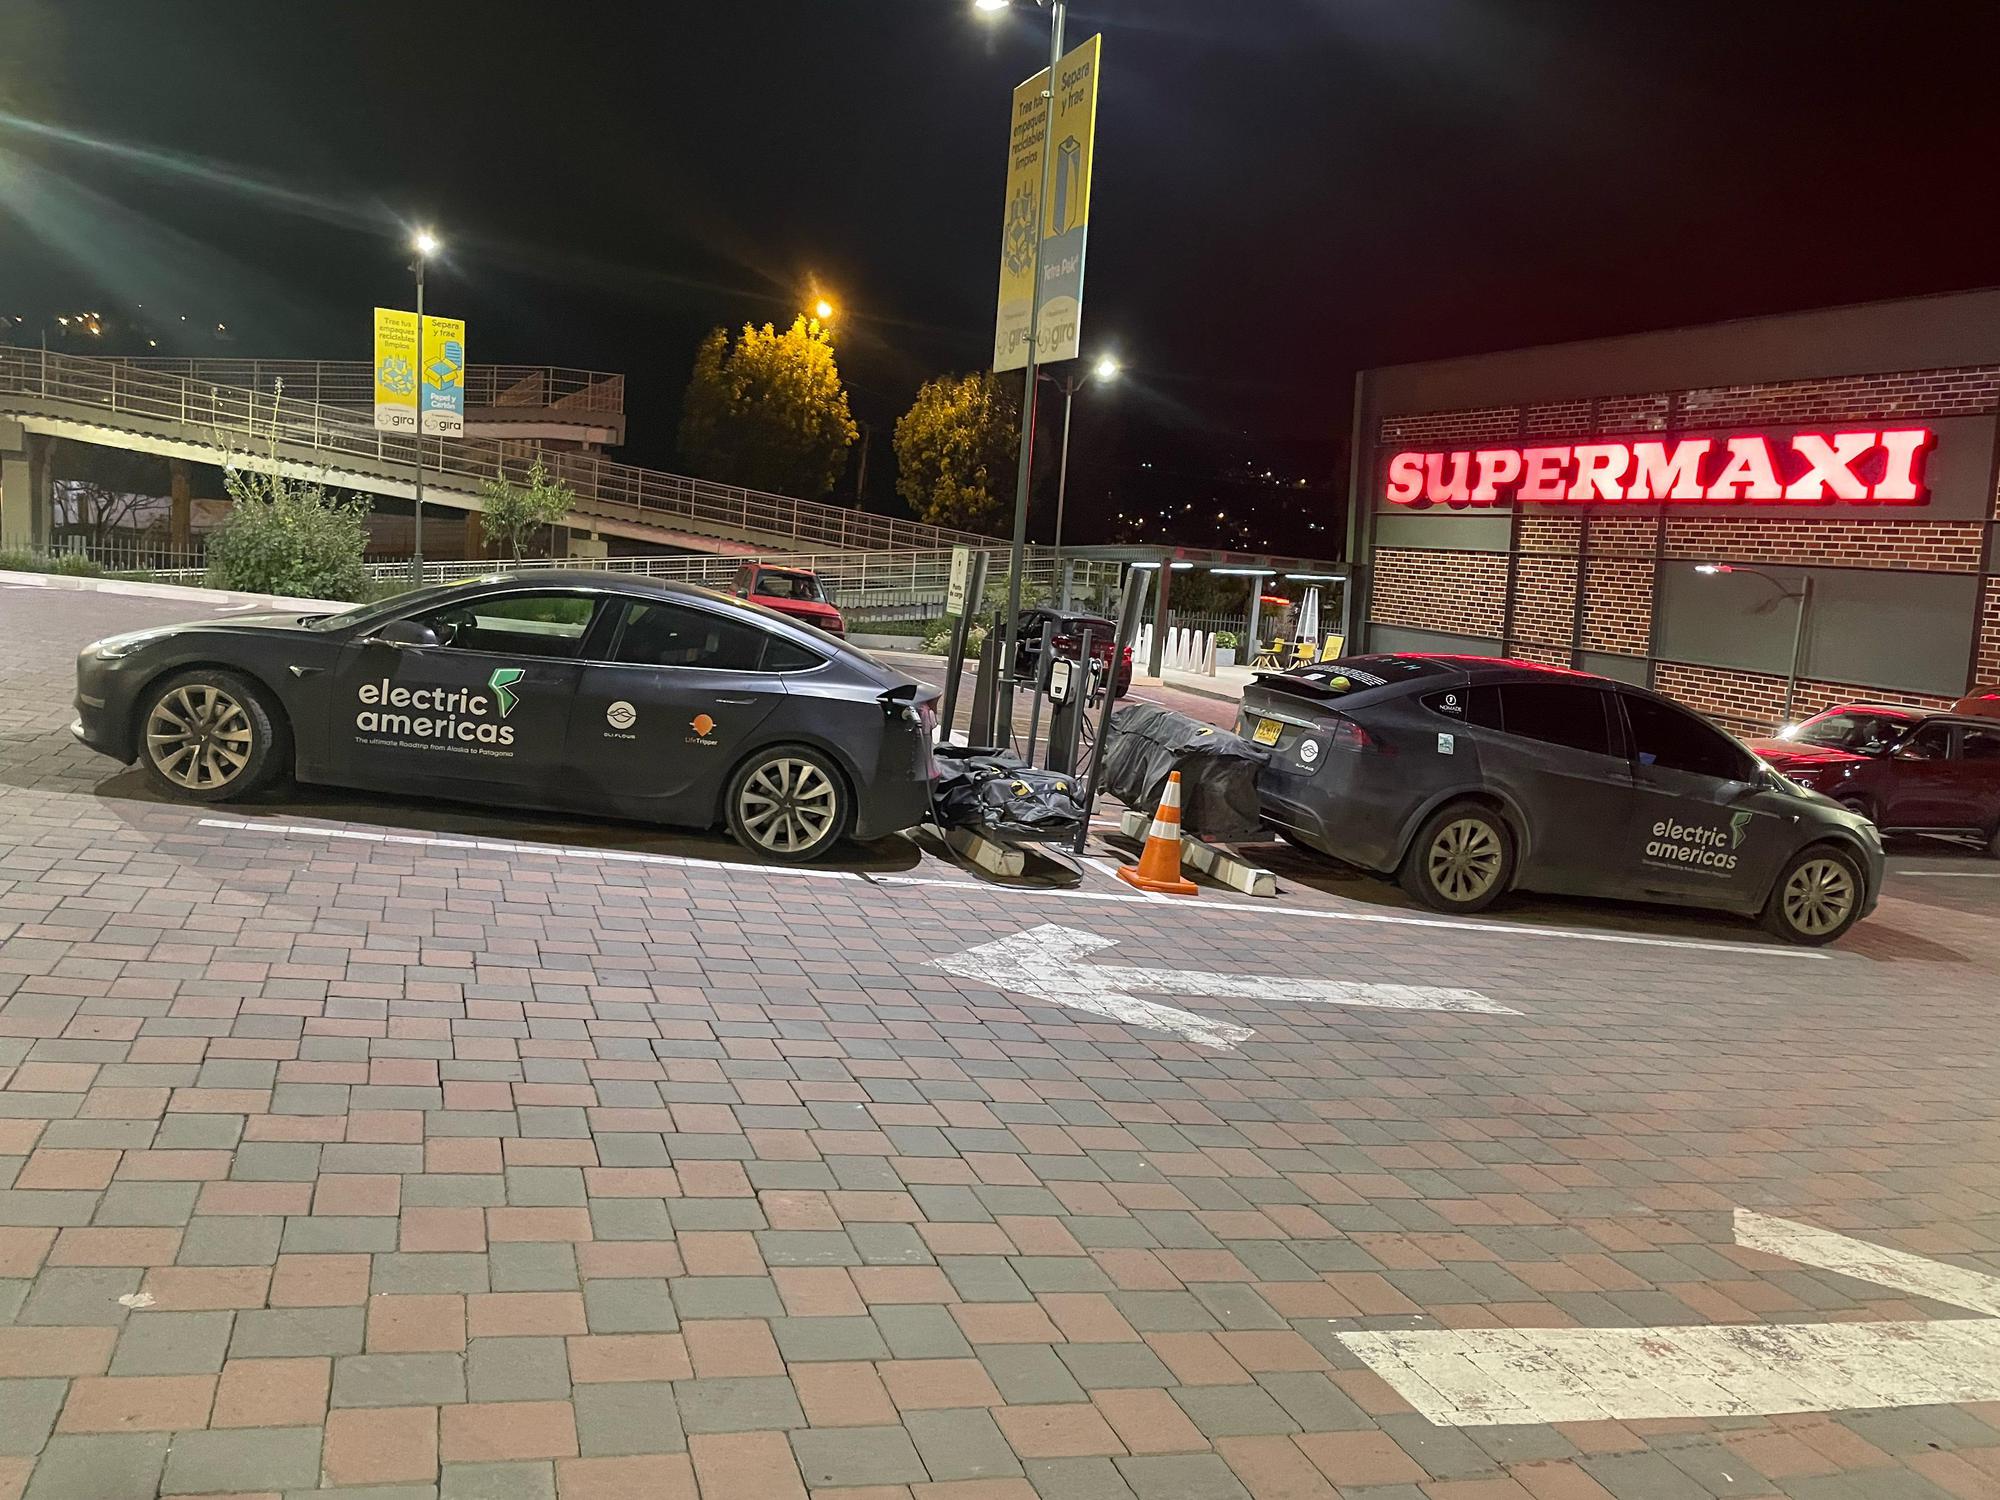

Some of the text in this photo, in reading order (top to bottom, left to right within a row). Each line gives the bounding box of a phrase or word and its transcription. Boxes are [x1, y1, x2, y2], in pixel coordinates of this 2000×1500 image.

[1061, 62, 1090, 91] Separa
[1019, 99, 1032, 117] Trae
[1061, 88, 1084, 117] y trae
[1013, 110, 1046, 140] empaques
[1015, 151, 1038, 171] limpios
[1044, 263, 1060, 281] Tetra
[379, 326, 415, 336] empaques
[384, 317, 400, 327] Trae
[432, 319, 460, 330] Separa
[440, 329, 456, 338] trae
[1051, 322, 1075, 350] gira
[384, 340, 410, 350] limpios
[392, 415, 415, 426] gira
[439, 420, 461, 431] gira
[1385, 428, 1931, 505] SUPERMAXI
[358, 678, 488, 716] electric
[356, 711, 515, 745] americas
[369, 737, 398, 747] ultimate
[399, 741, 429, 750] Roadtrip
[430, 743, 446, 751] from
[447, 745, 469, 753] Alaska
[479, 749, 514, 758] Patagonia
[1652, 818, 1727, 847] electric
[1645, 841, 1739, 869] americas
